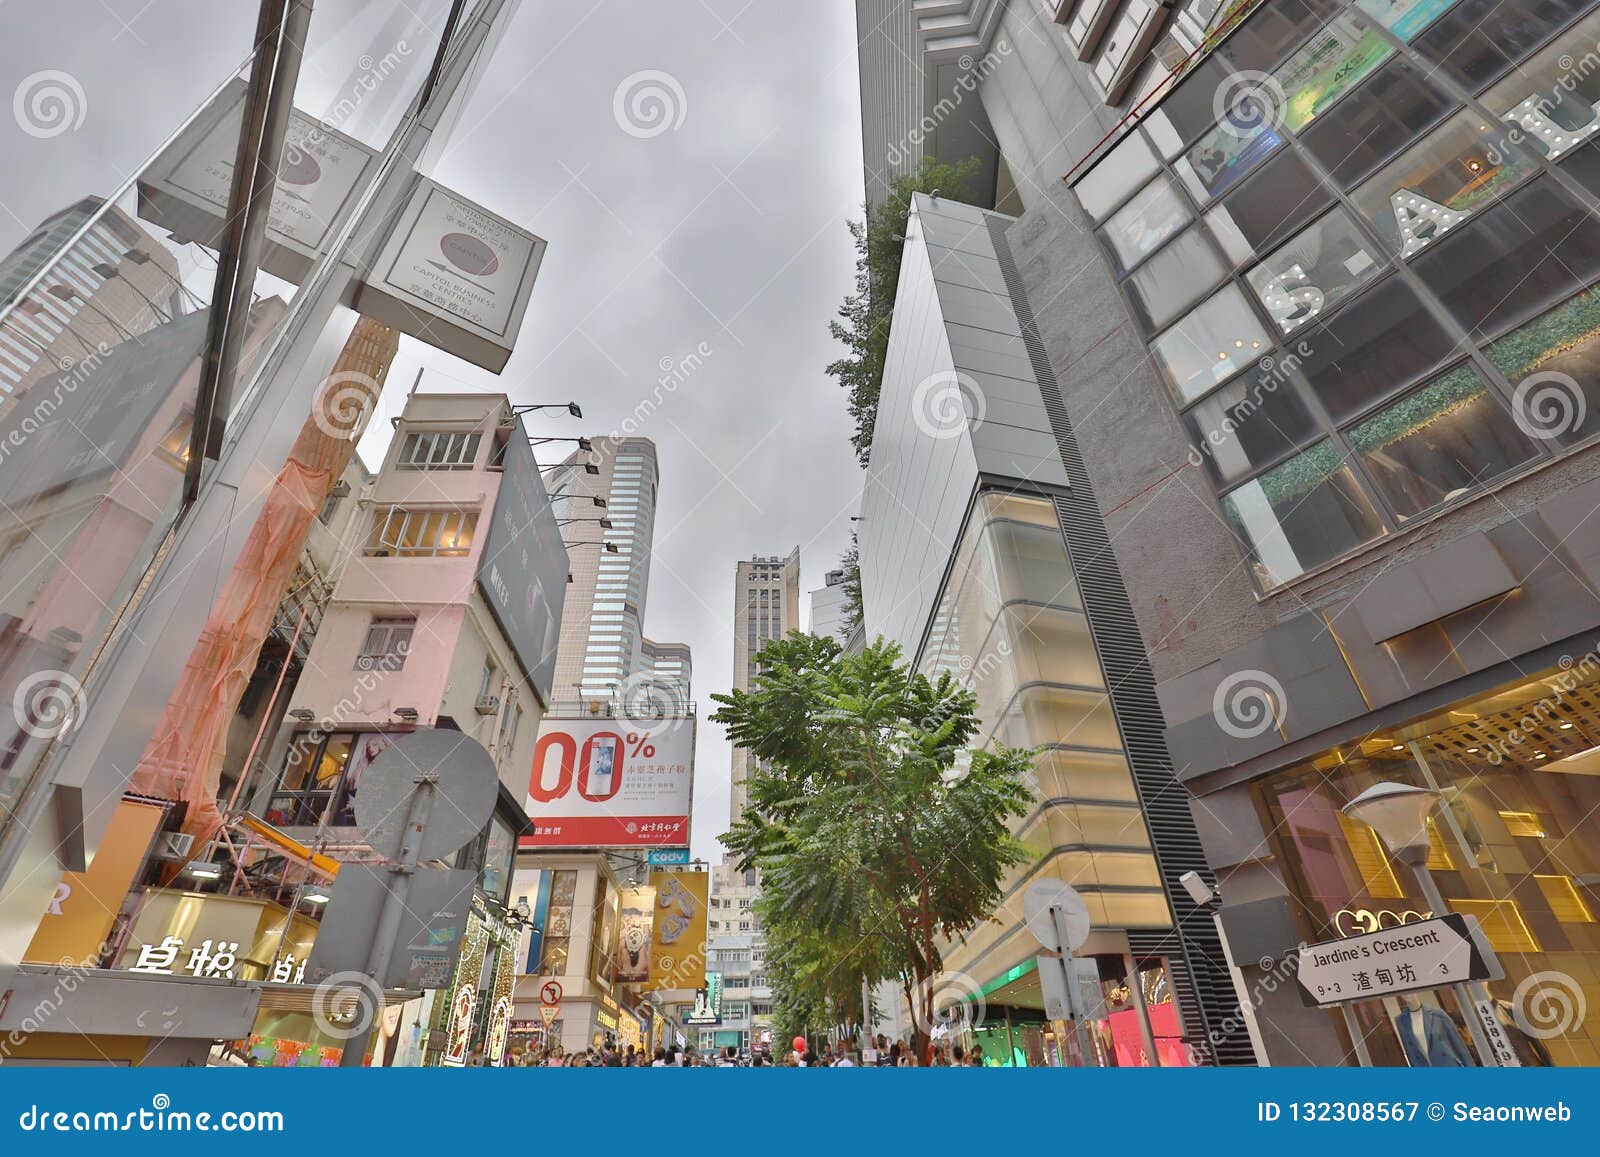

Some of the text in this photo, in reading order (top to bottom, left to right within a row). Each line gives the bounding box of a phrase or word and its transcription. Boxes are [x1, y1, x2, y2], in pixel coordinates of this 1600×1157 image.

[1313, 929, 1441, 968] Jardine's Crescent
[1352, 963, 1417, 992] 渣甸坊
[1439, 963, 1449, 975] 3
